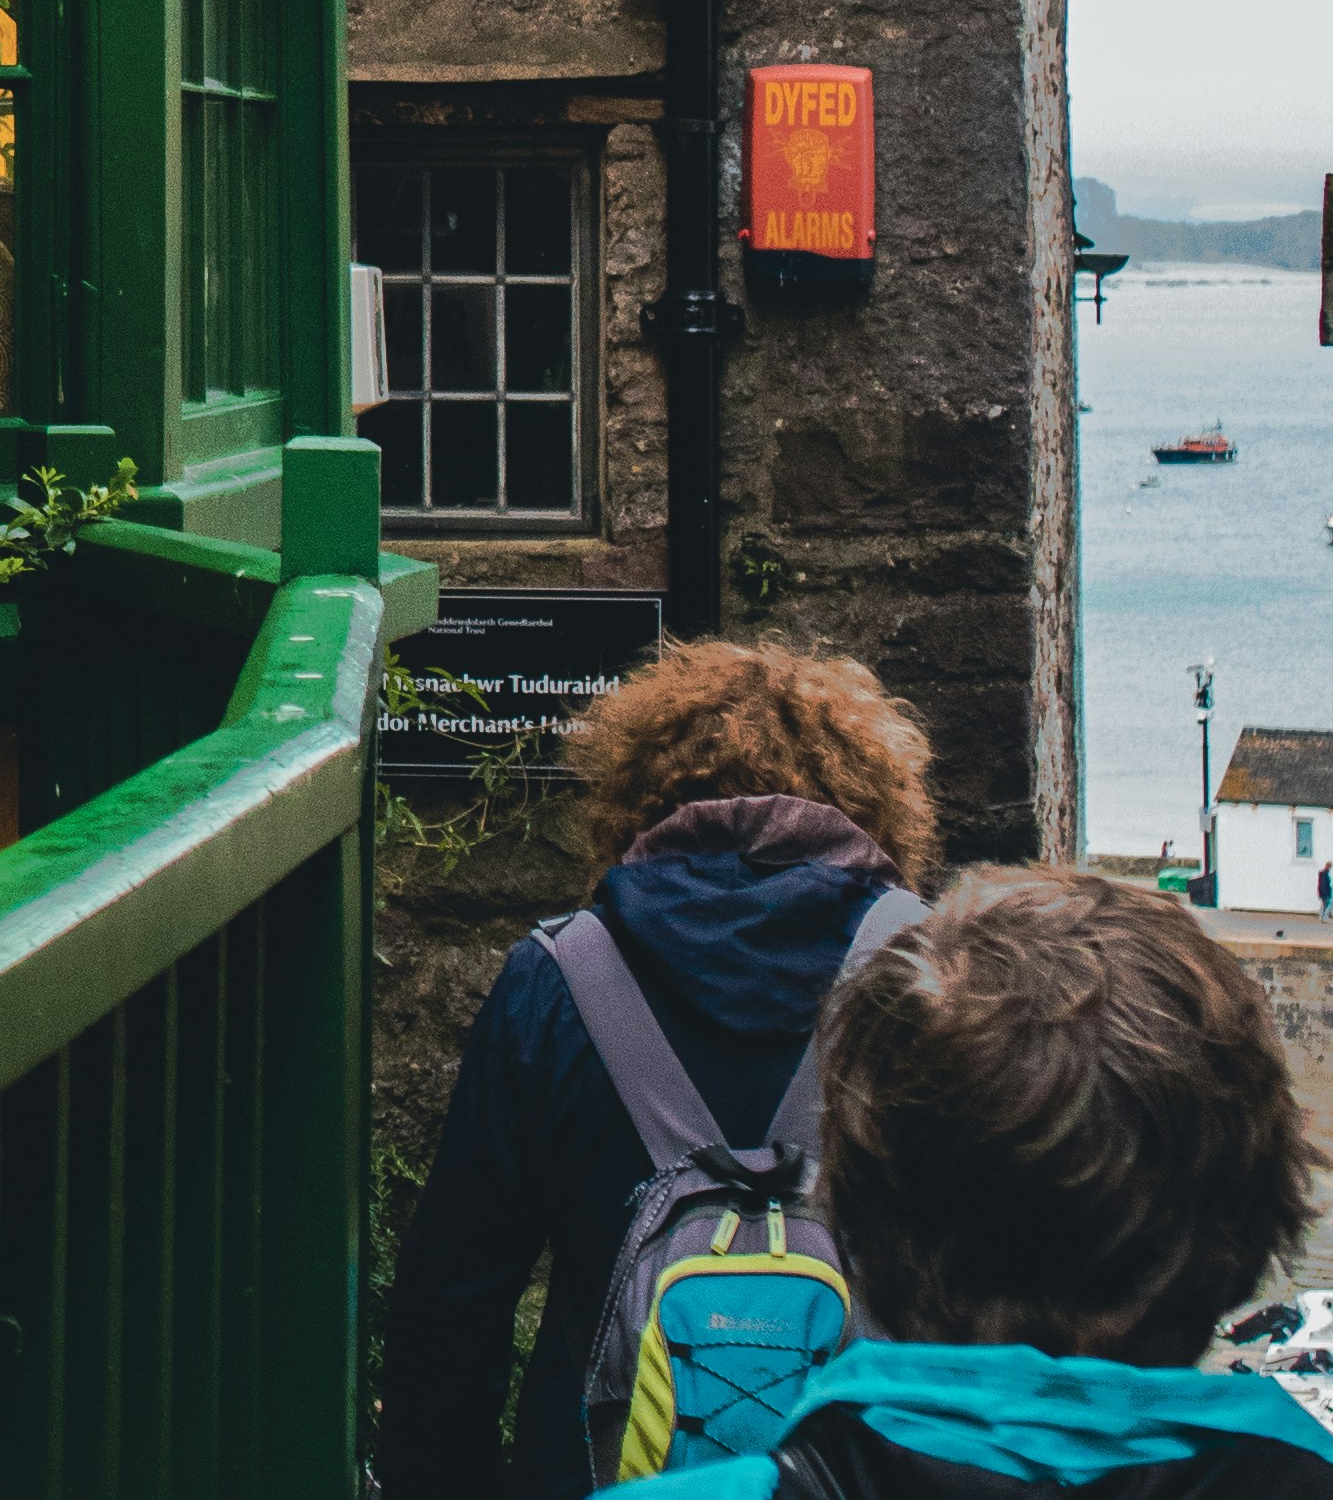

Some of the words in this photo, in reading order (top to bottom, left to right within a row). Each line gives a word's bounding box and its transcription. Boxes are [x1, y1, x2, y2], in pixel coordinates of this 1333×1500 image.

[765, 81, 856, 126] DYFED
[765, 210, 853, 249] ALARMS
[428, 626, 463, 634] National
[465, 626, 486, 635] Trust
[507, 673, 620, 696] Tuduraidd
